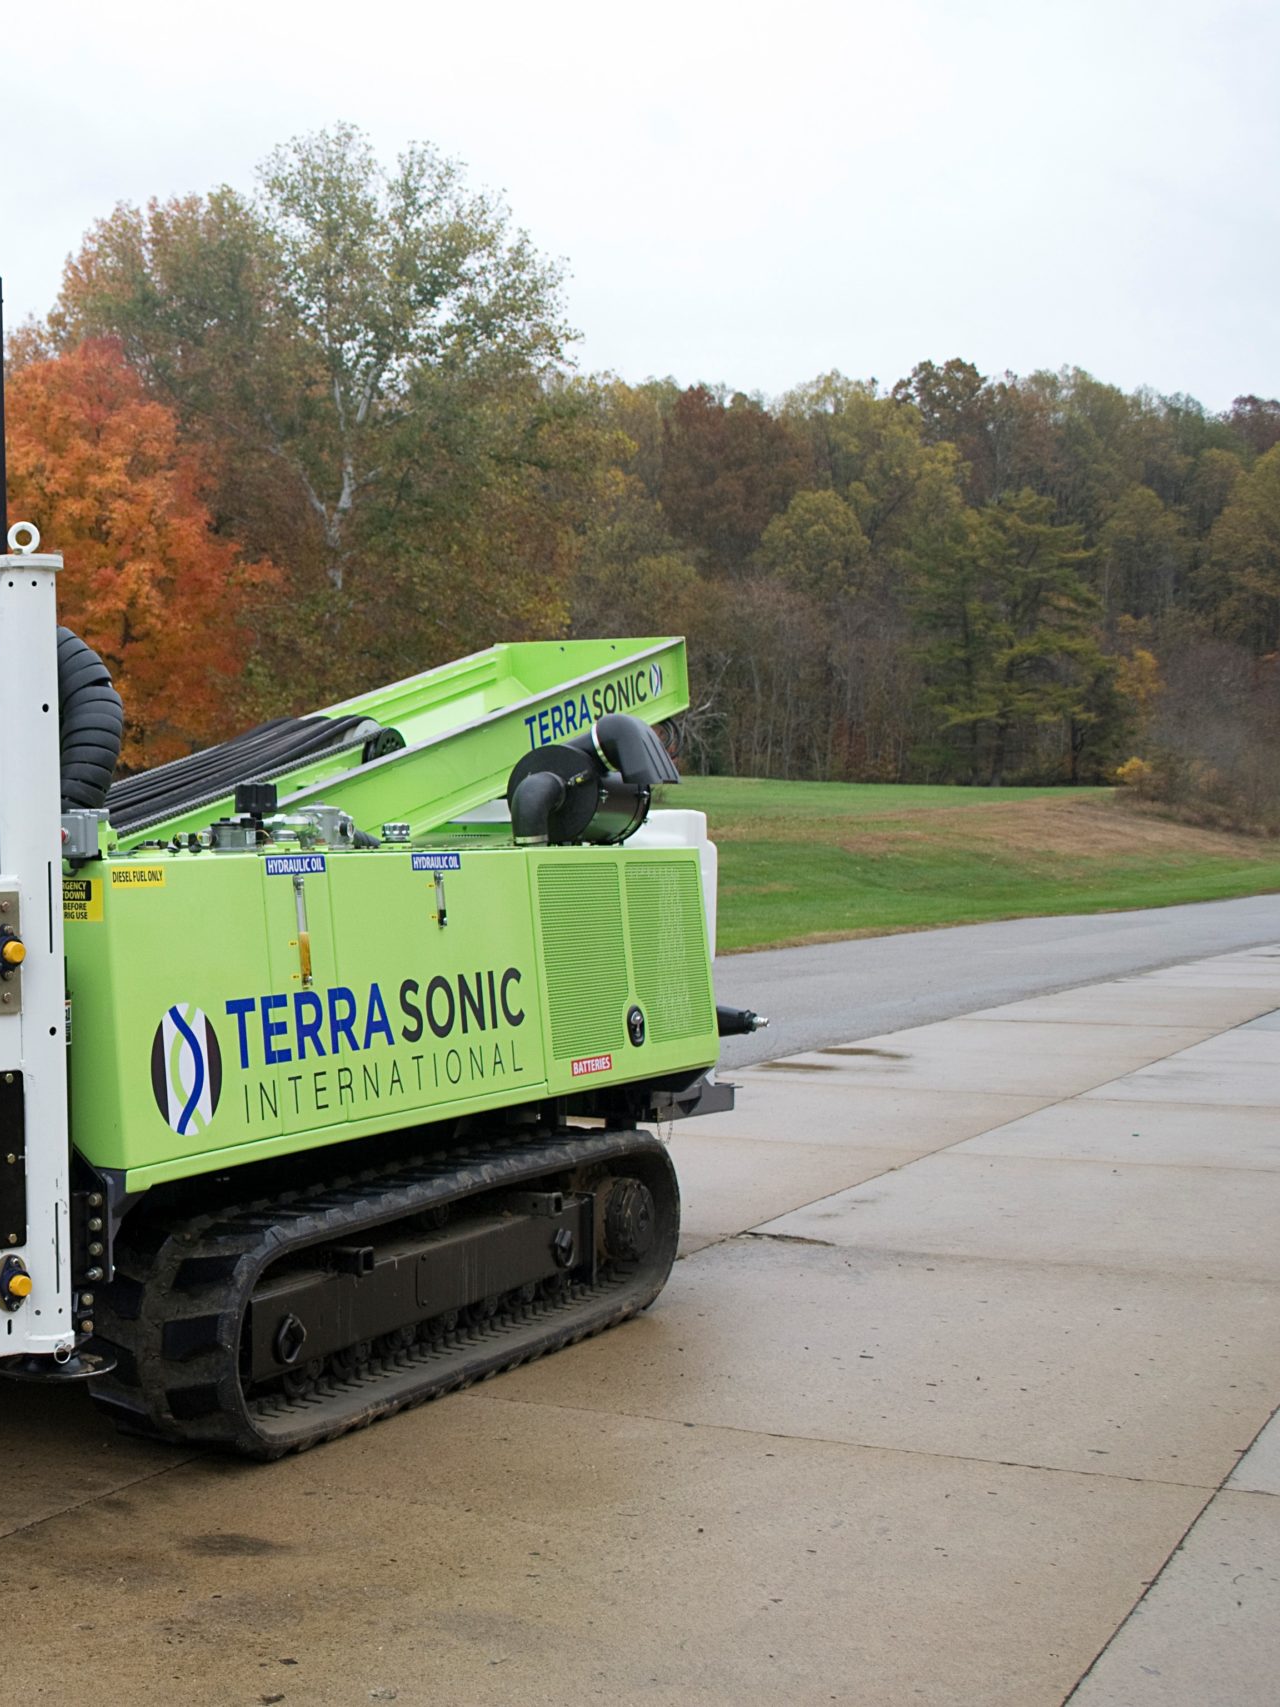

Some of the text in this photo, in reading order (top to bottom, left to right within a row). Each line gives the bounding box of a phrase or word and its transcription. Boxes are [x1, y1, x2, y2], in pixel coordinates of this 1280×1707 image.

[524, 670, 647, 750] TERRASONIC
[267, 857, 325, 874] HYDRAULIC OIL
[412, 855, 460, 869] HYDRAULIC OIL
[112, 869, 163, 883] DIESEL FUEL ONLY
[62, 881, 87, 890] RGENCY
[63, 890, 86, 900] DOWN
[63, 902, 87, 911] BEFORE
[64, 911, 88, 920] RIG USE
[225, 967, 526, 1070] TERRASONIC
[573, 1056, 611, 1075] BATTERIES
[244, 1039, 524, 1124] INTERNATIONAL
